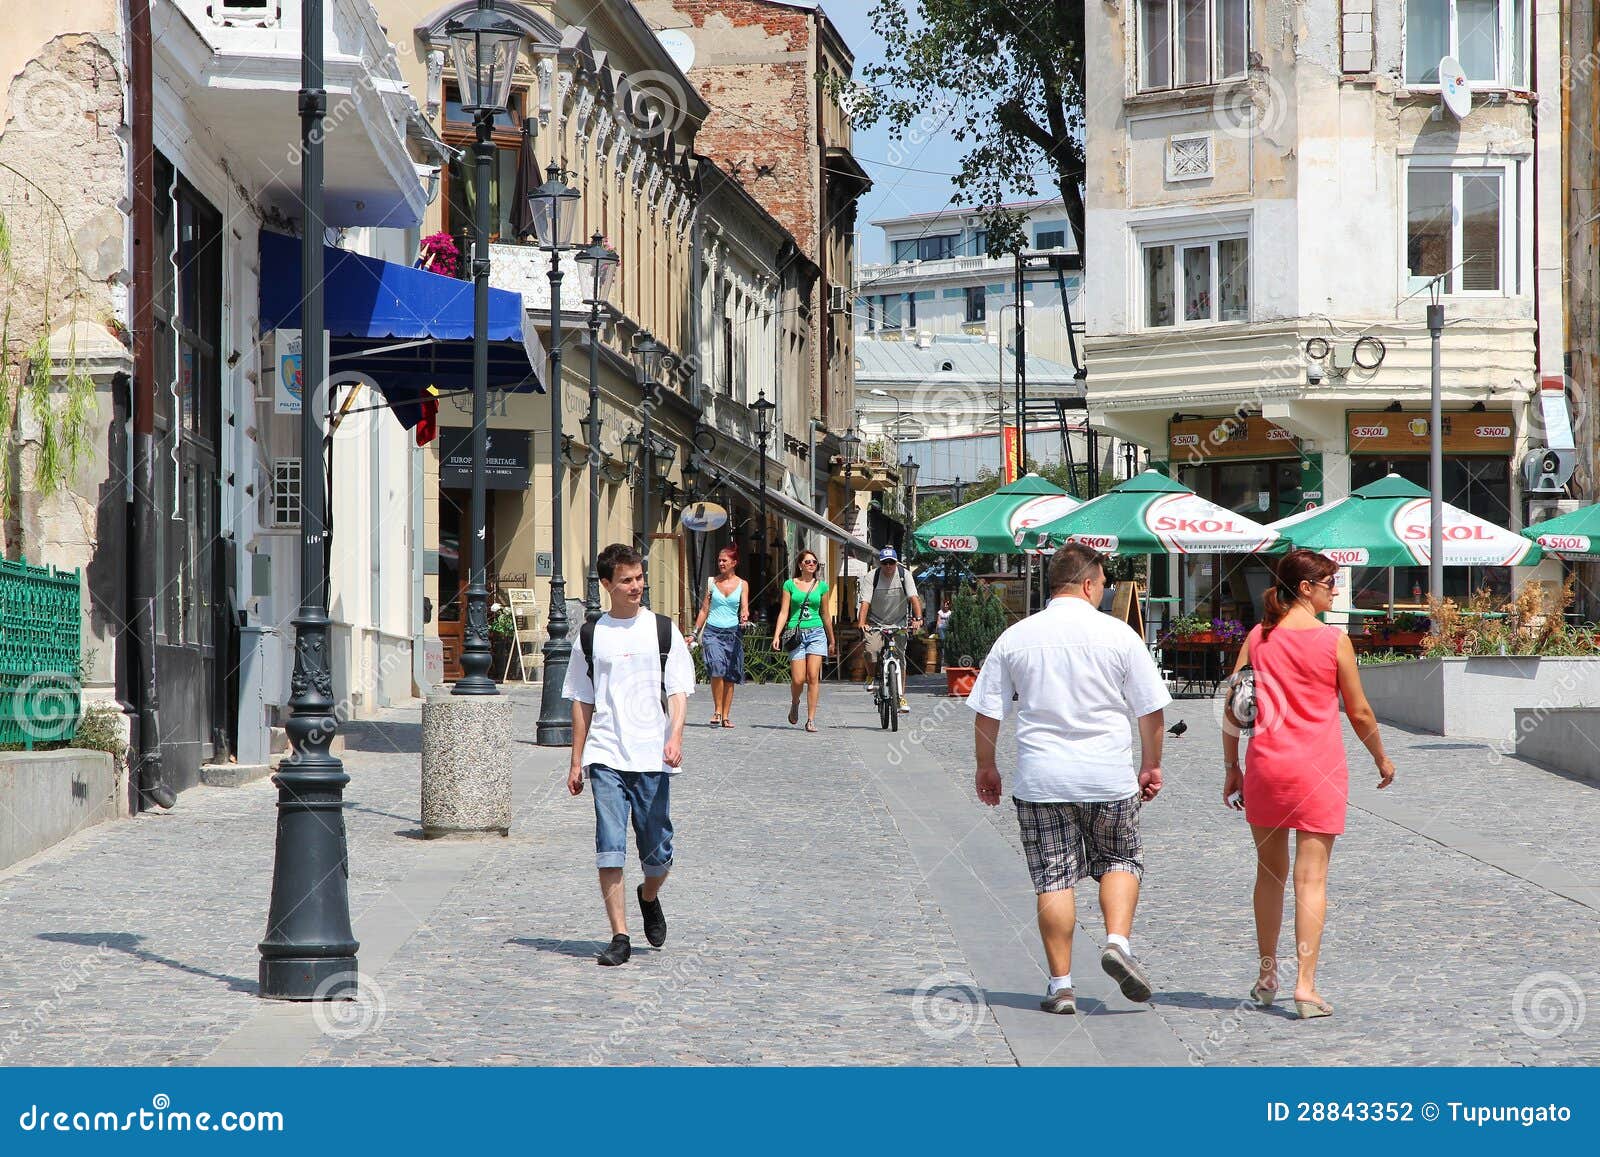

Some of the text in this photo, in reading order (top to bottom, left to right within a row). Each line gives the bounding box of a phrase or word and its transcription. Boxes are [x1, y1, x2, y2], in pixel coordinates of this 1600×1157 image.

[1272, 430, 1291, 438] SKOL
[1360, 427, 1385, 436] SKOL
[1482, 427, 1507, 436] SKOL
[1178, 435, 1196, 443] SKOL
[450, 456, 473, 464] EUROP
[1154, 516, 1244, 533] SKOL
[940, 538, 972, 549] SKOL
[1080, 538, 1112, 549] SKOL
[1549, 537, 1584, 549] SKOL
[1329, 551, 1363, 562] SKOL
